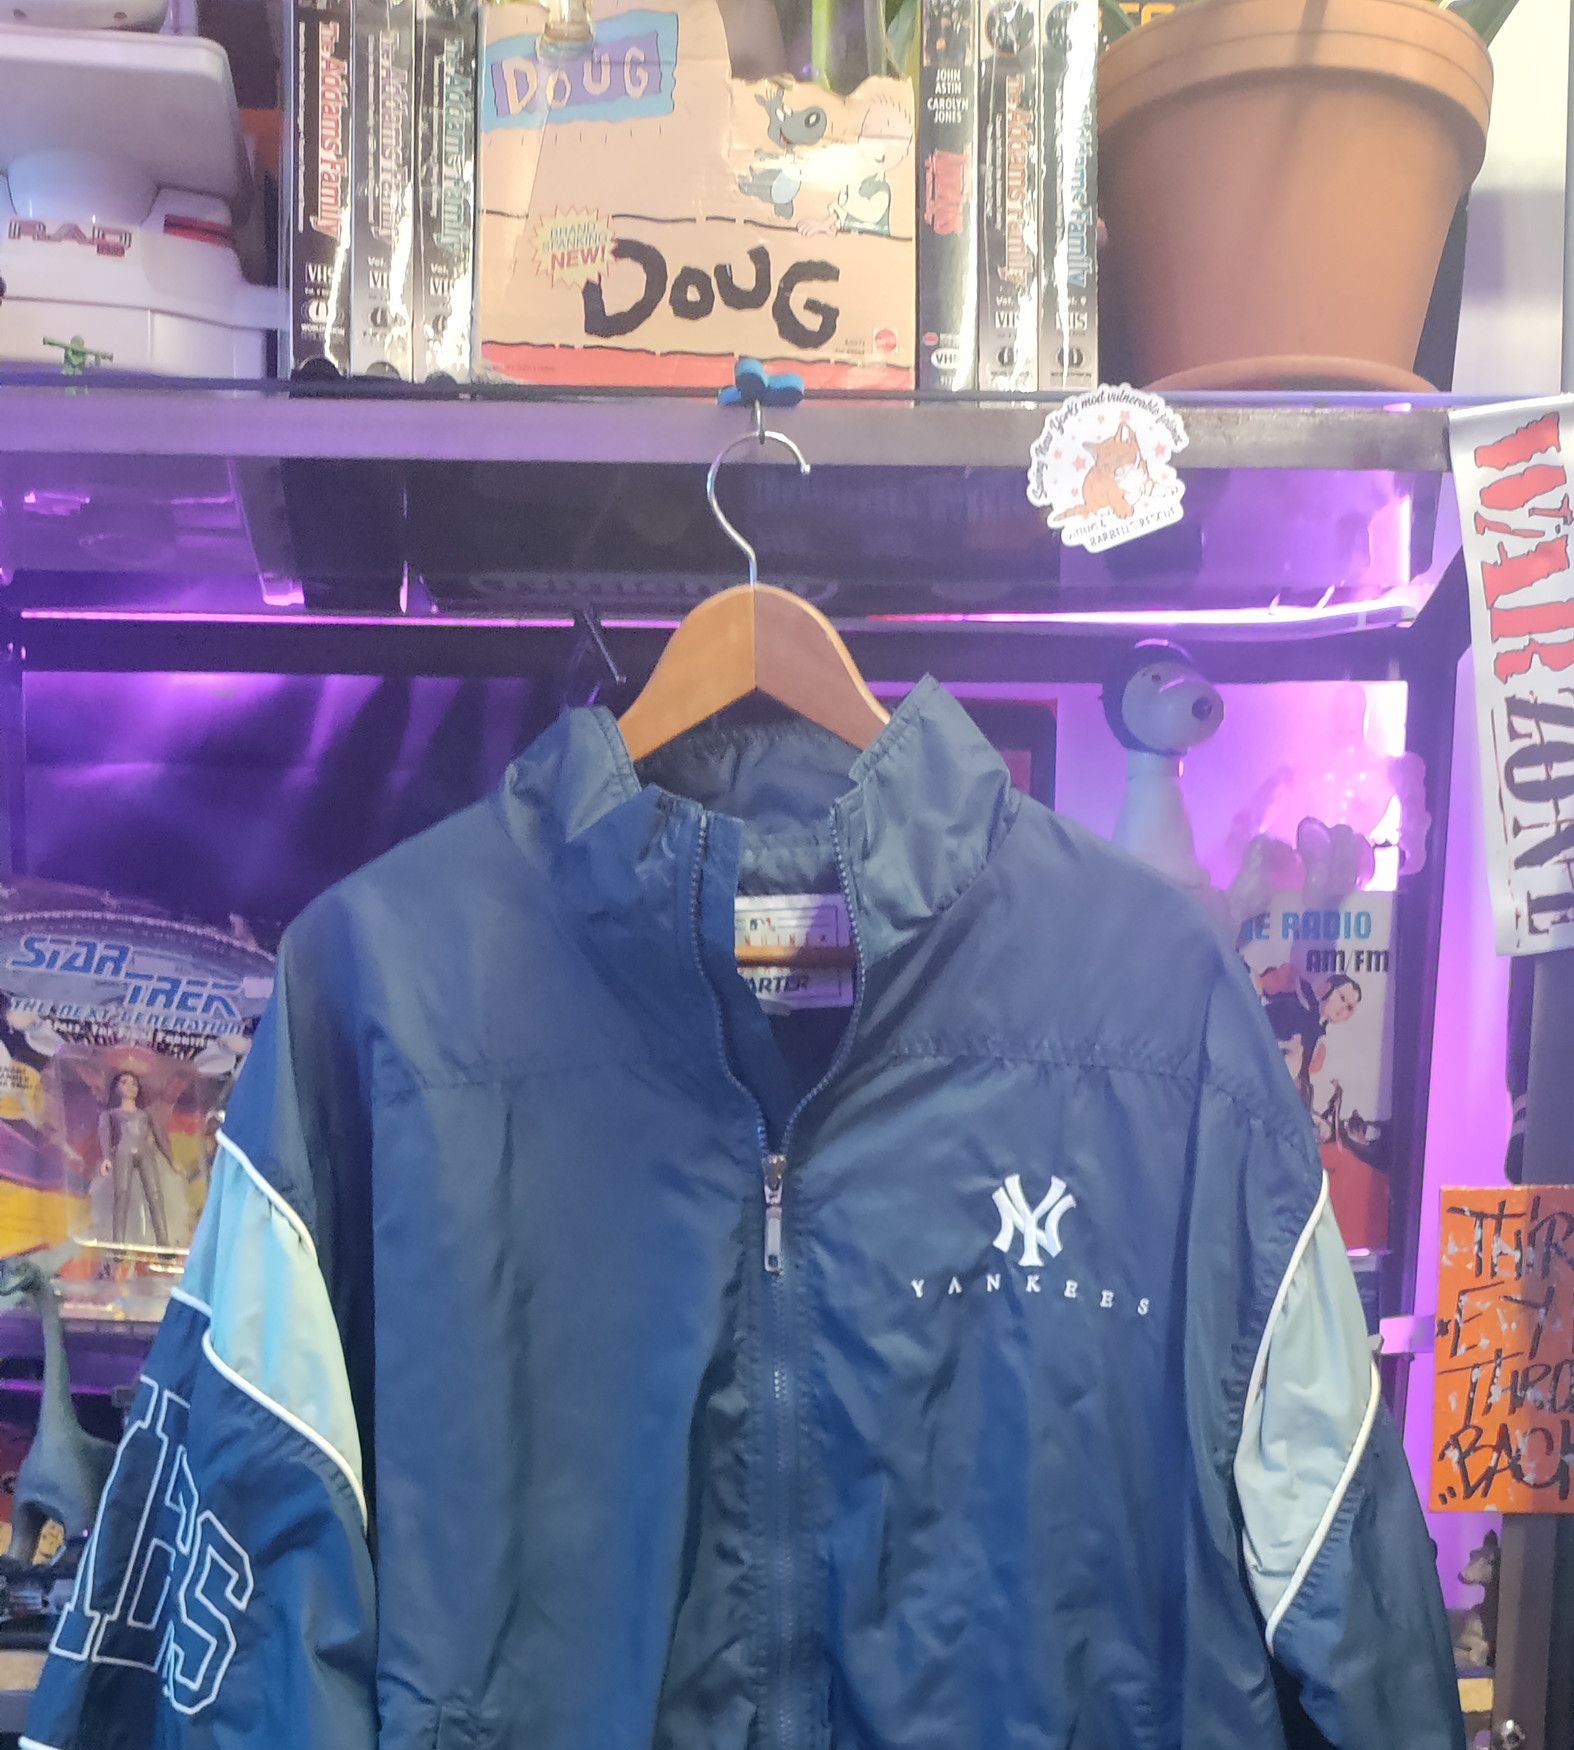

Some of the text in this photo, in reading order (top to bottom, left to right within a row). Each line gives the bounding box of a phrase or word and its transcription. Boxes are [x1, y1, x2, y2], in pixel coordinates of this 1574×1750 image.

[319, 57, 347, 155] Addams
[502, 47, 649, 115] DOUG
[927, 97, 969, 111] CAROLYN
[935, 69, 962, 82] JOHN
[935, 82, 962, 95] ASTIN
[380, 66, 408, 161] Addams
[934, 109, 963, 123] JONES
[308, 156, 347, 240] Family
[582, 239, 841, 350] DOUG
[1474, 411, 1574, 938] WAR ZONE
[1281, 911, 1372, 941] RADIO
[12, 934, 242, 1020] STAR TREK
[910, 1272, 1150, 1316] YANKEES
